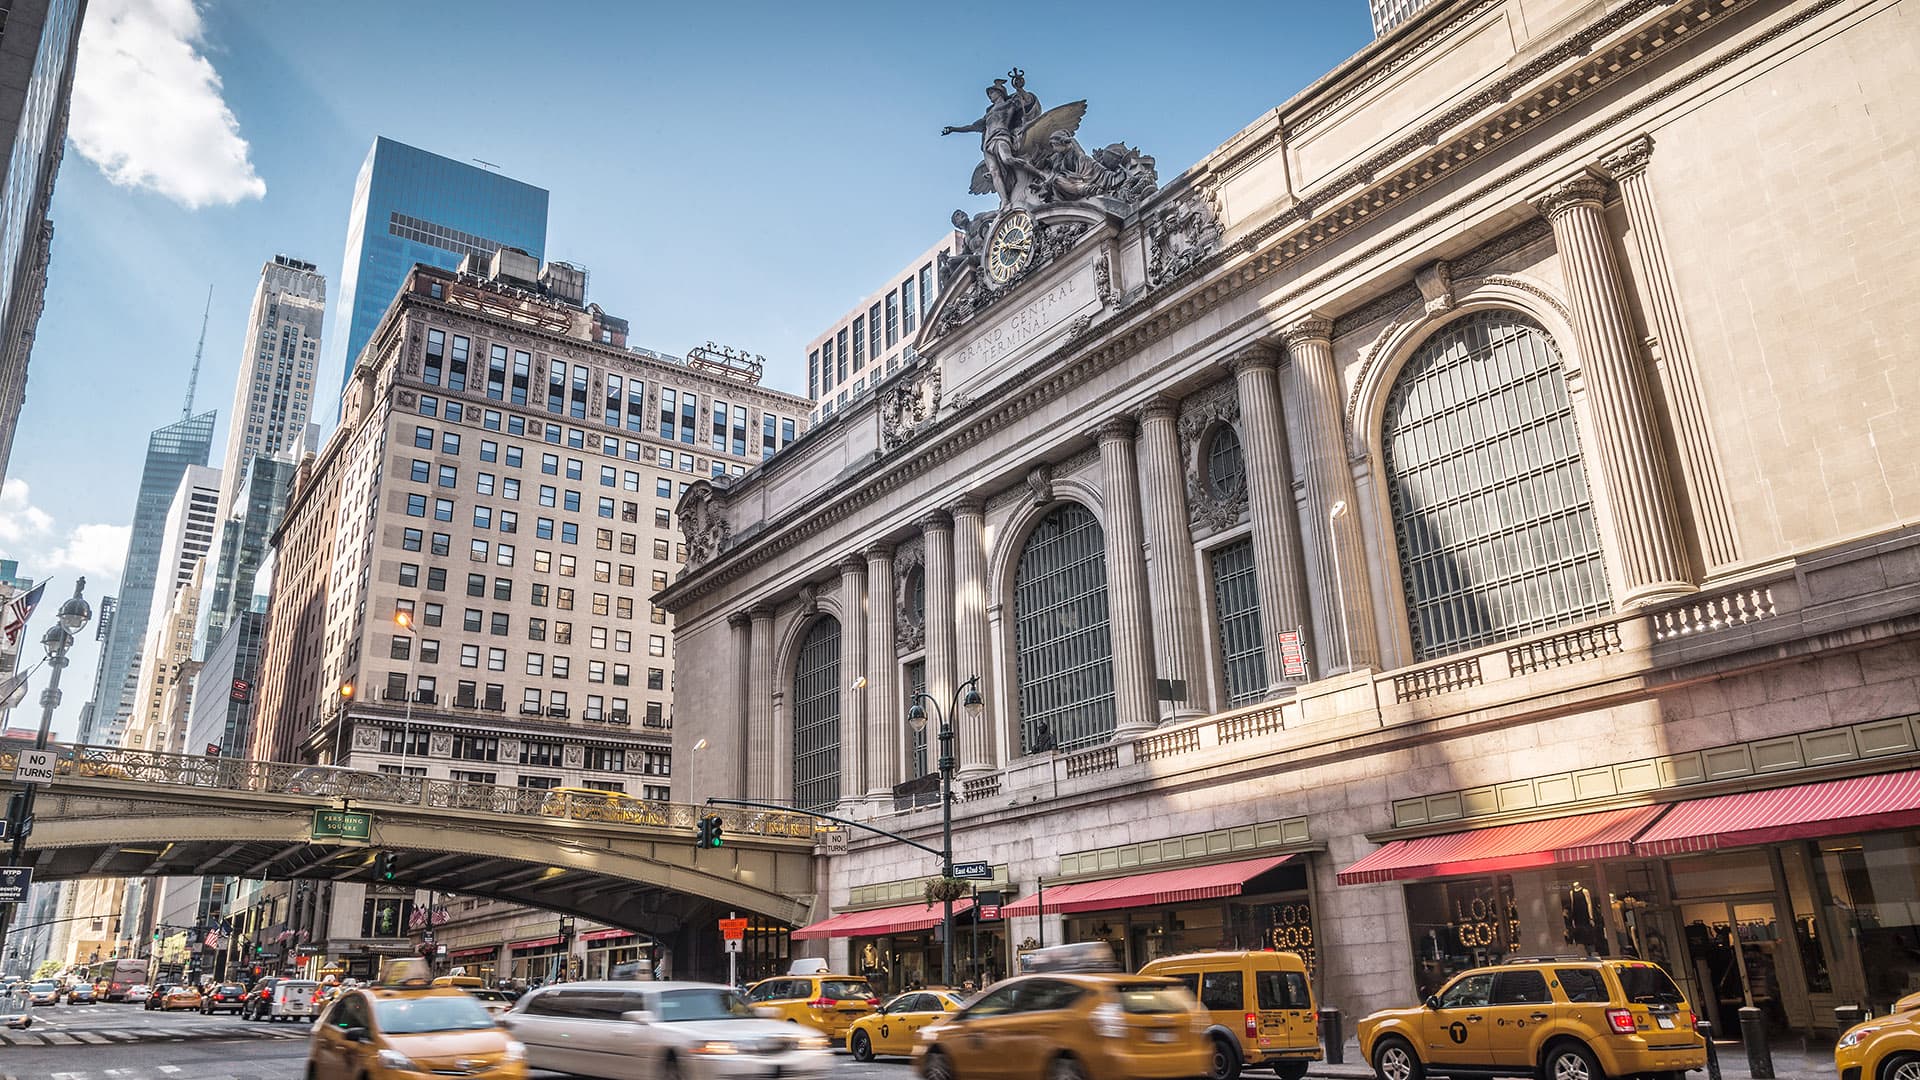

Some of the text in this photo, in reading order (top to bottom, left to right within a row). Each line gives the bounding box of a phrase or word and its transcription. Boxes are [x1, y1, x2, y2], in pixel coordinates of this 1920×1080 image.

[958, 280, 1076, 364] GRAND CENTRAL
[982, 313, 1049, 363] TERMINAL
[29, 755, 46, 765] NO
[19, 767, 52, 778] TURNS
[324, 815, 363, 824] PERSHING
[327, 823, 357, 831] SQUARE
[831, 835, 842, 843] NO
[955, 864, 985, 875] East 42nd St
[0, 885, 22, 893] ecurity
[1272, 904, 1310, 926] LOO
[1273, 925, 1312, 949] GOO
[1452, 1025, 1463, 1041] T
